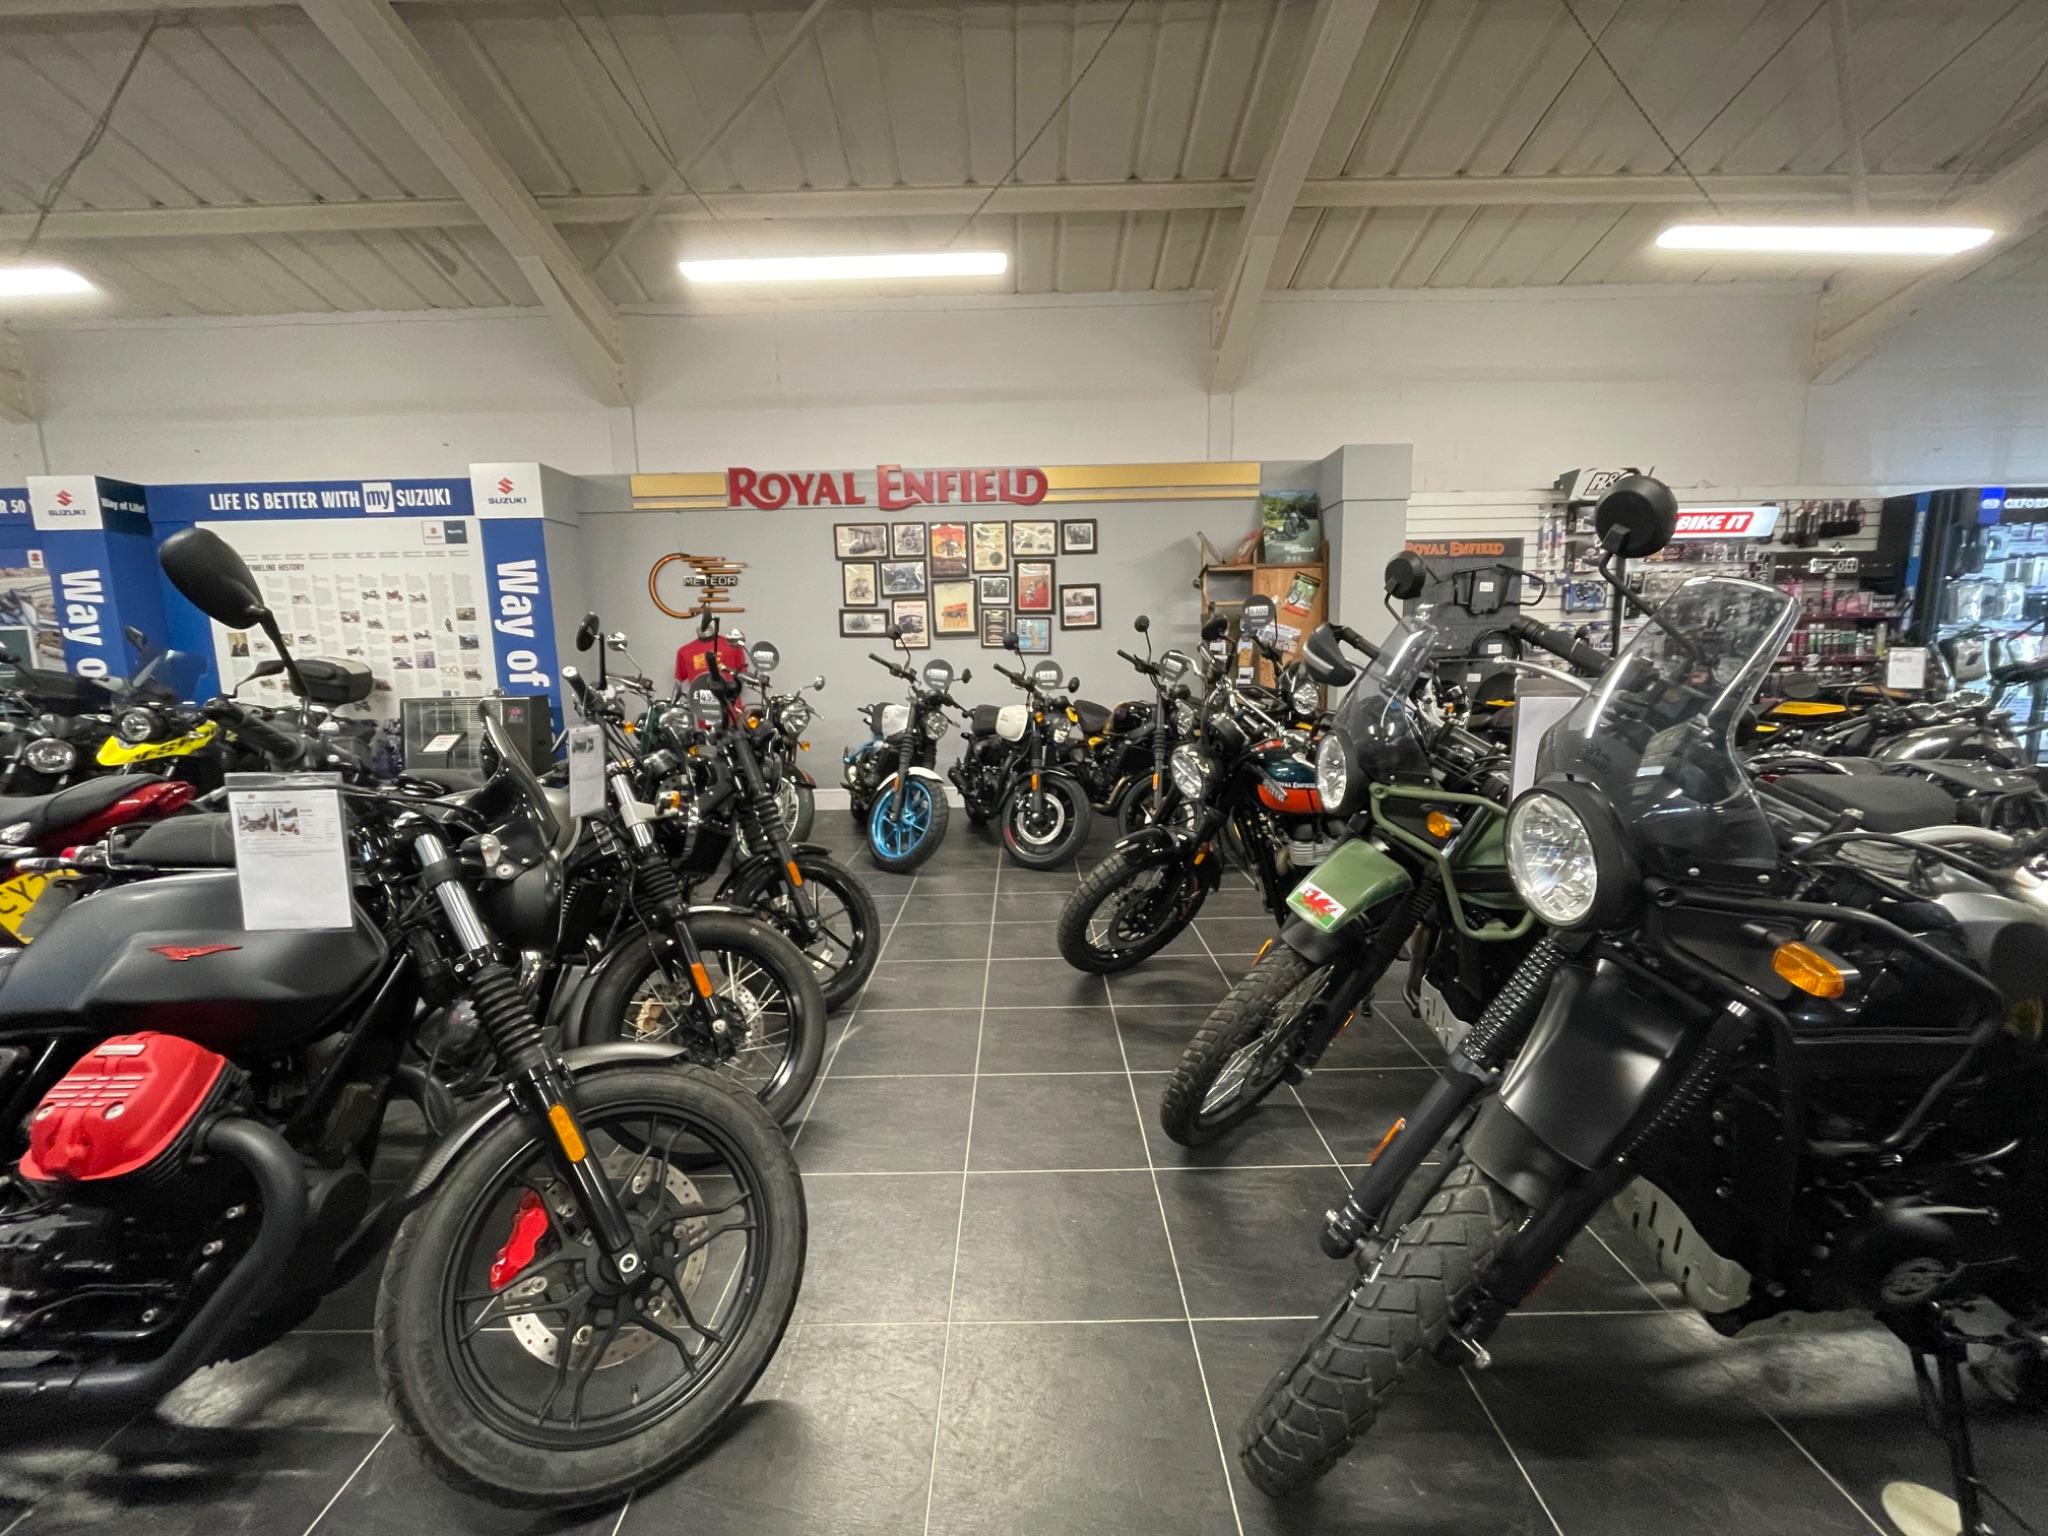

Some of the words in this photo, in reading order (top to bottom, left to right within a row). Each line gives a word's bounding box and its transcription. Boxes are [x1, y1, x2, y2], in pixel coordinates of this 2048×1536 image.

[728, 467, 866, 511] ROYAL
[877, 464, 1048, 511] ENFIELD
[11, 499, 26, 513] 50
[209, 493, 242, 511] LIFE
[244, 492, 260, 510] IS
[262, 491, 319, 510] BETTER
[320, 490, 360, 508] WITH
[366, 490, 390, 510] my
[395, 488, 451, 507] SUZUKI
[1677, 514, 1727, 530] BIKE
[1724, 514, 1751, 530] IT
[1449, 541, 1505, 556] ENFIELD
[684, 576, 737, 586] METEOR
[61, 569, 104, 646] Way
[494, 559, 540, 638] Way
[76, 657, 107, 678] o
[506, 649, 550, 687] of
